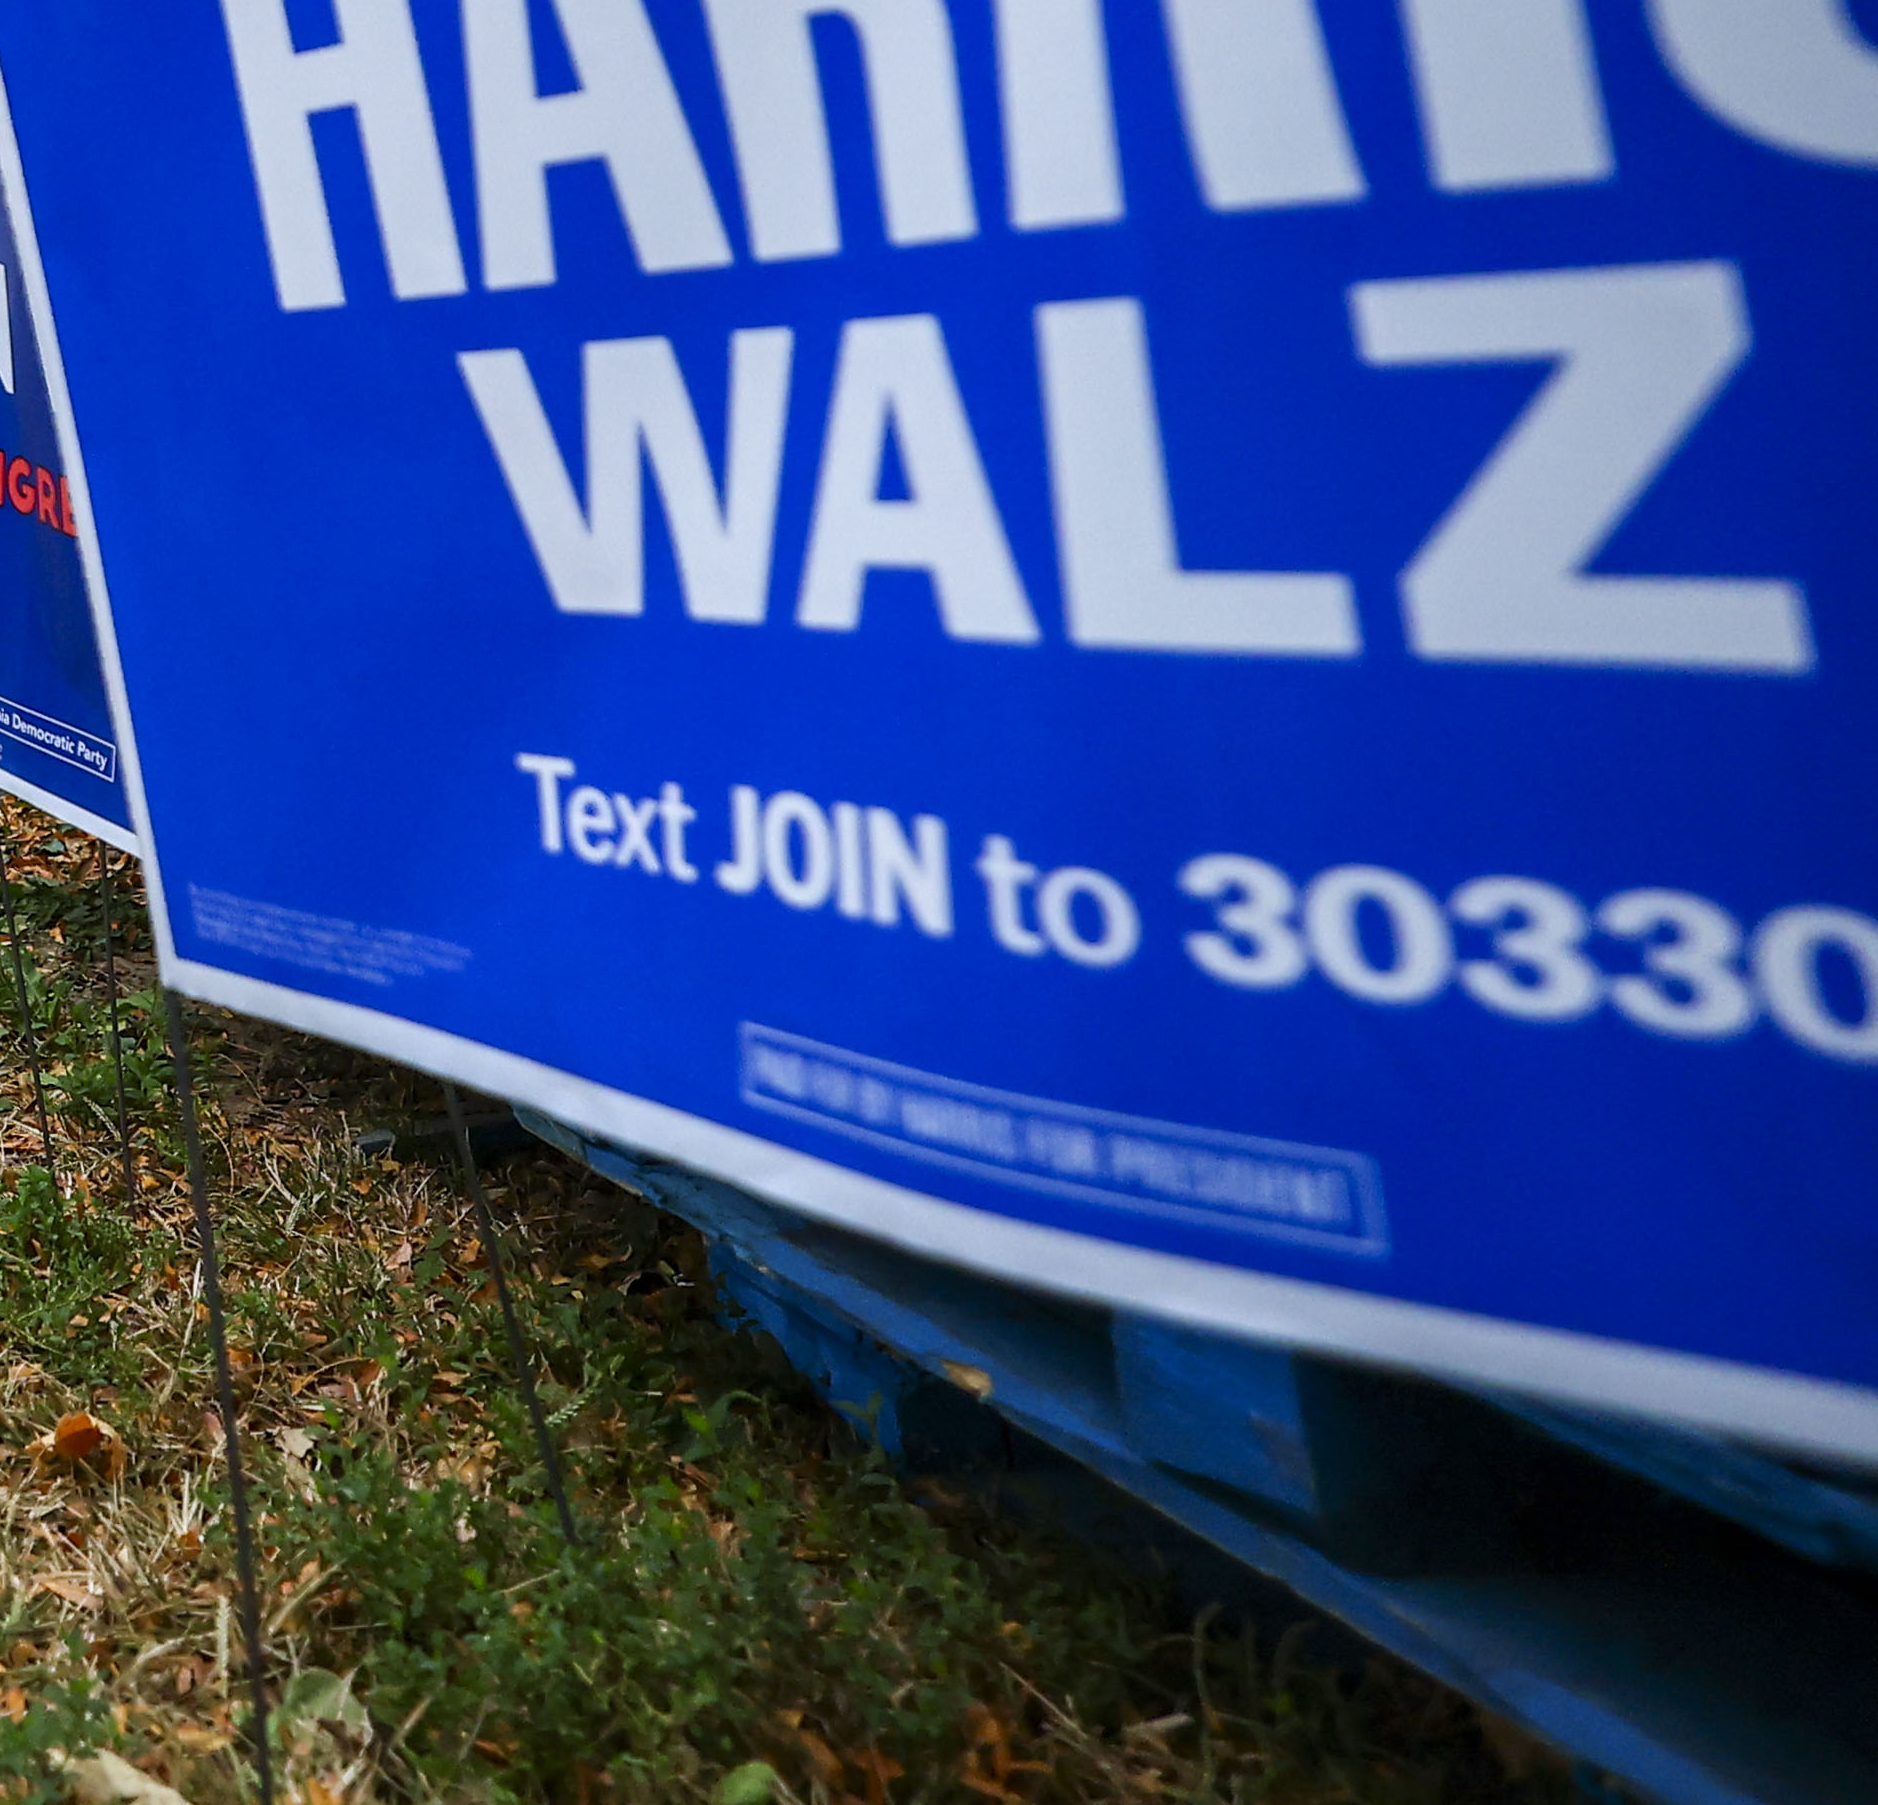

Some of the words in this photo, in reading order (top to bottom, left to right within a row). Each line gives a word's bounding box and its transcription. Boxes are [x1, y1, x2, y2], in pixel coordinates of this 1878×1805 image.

[457, 260, 1816, 677] WALZ
[12, 713, 76, 755] Democratic
[77, 743, 108, 773] Party
[516, 751, 699, 885] Text
[714, 782, 955, 941] JOIN
[977, 833, 1142, 971] to
[1178, 850, 1878, 1067] 30330
